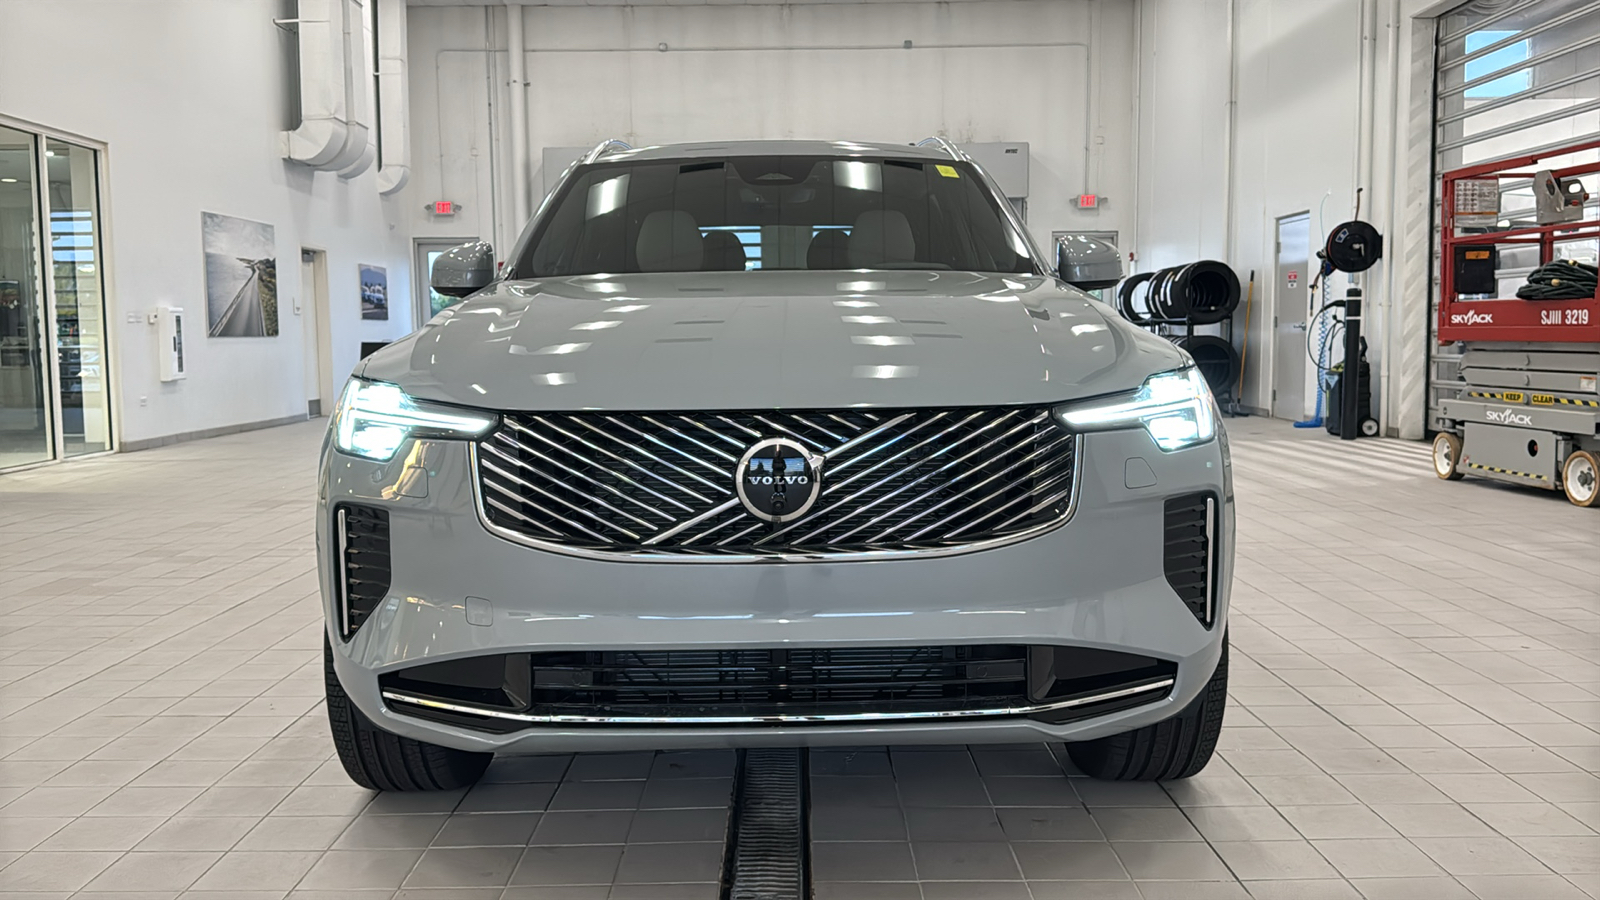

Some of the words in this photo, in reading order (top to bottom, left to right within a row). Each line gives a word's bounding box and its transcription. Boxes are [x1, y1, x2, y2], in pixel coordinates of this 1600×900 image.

[436, 201, 451, 213] EXIT
[1081, 194, 1095, 207] EXIT
[1451, 309, 1493, 325] SKYJACK
[1565, 309, 1589, 325] 3219
[1505, 393, 1521, 401] KEEP
[1532, 395, 1553, 404] CLEAR
[1486, 408, 1532, 426] SKYJACK
[748, 475, 809, 486] VOLVO
